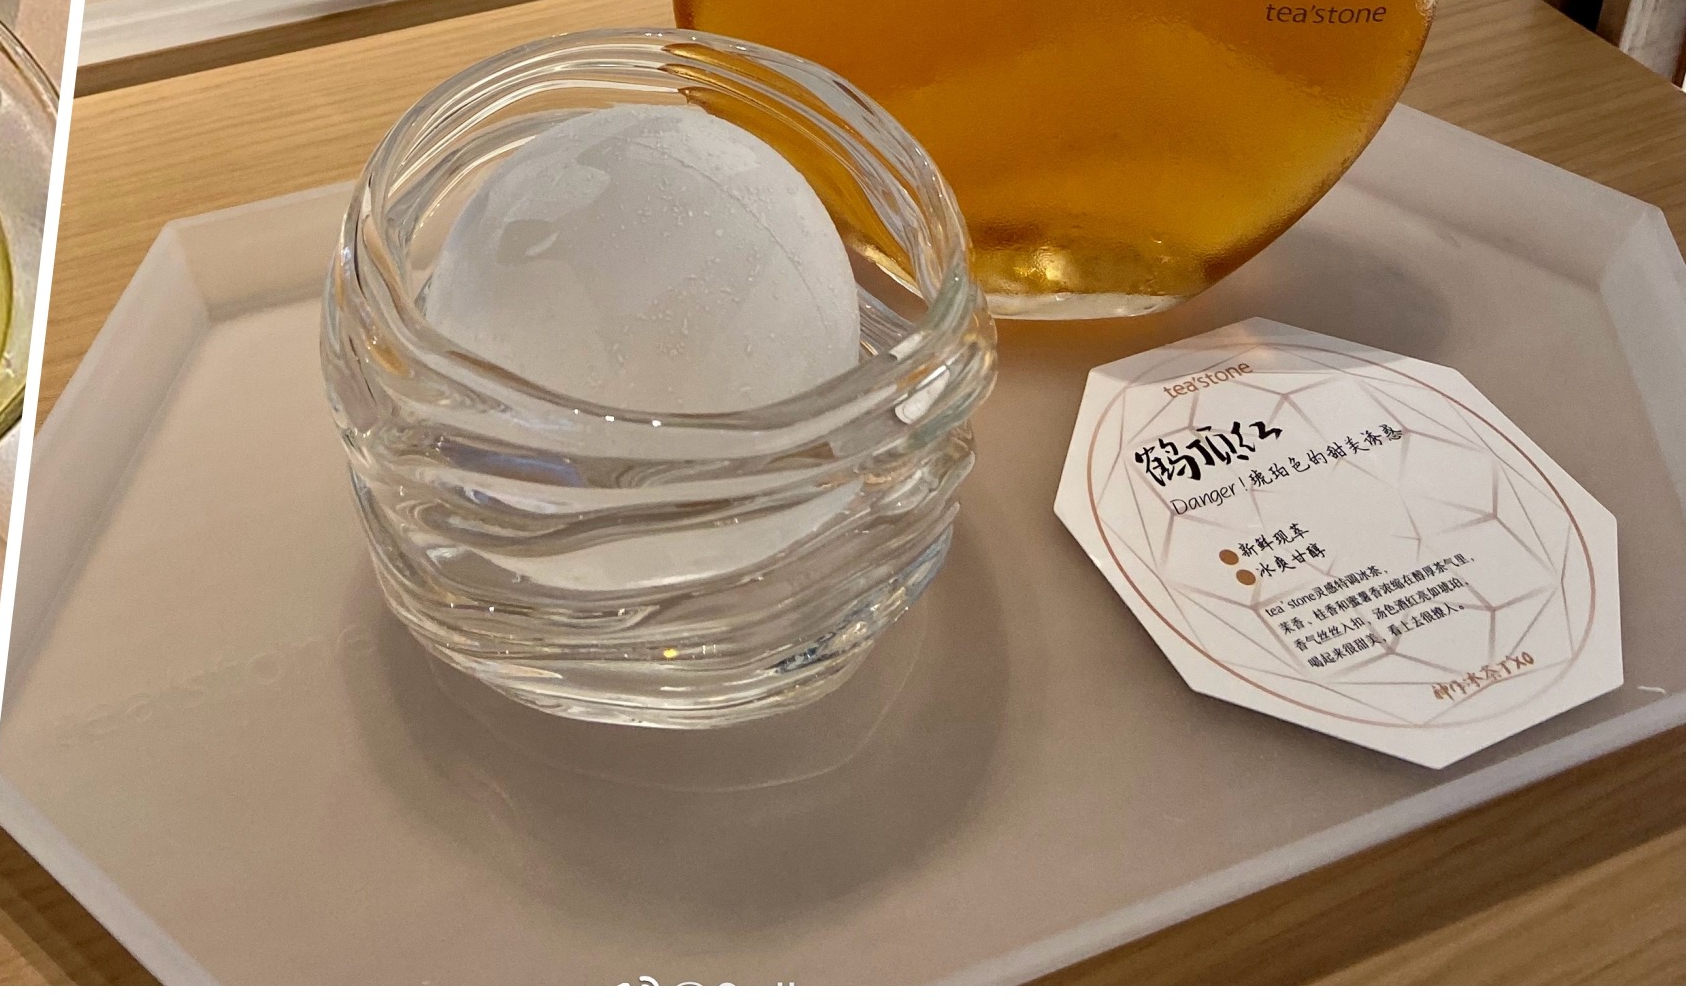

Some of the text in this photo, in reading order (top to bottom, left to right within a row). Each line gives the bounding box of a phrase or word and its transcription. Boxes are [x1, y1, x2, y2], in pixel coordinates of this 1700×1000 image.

[1265, 3, 1387, 24] tea'stone
[1163, 361, 1254, 400] tea'stone
[1134, 421, 1283, 487] 鹤顶红
[1238, 522, 1310, 559] 新鲜现萃
[1258, 542, 1327, 579] 冰爽甘醇
